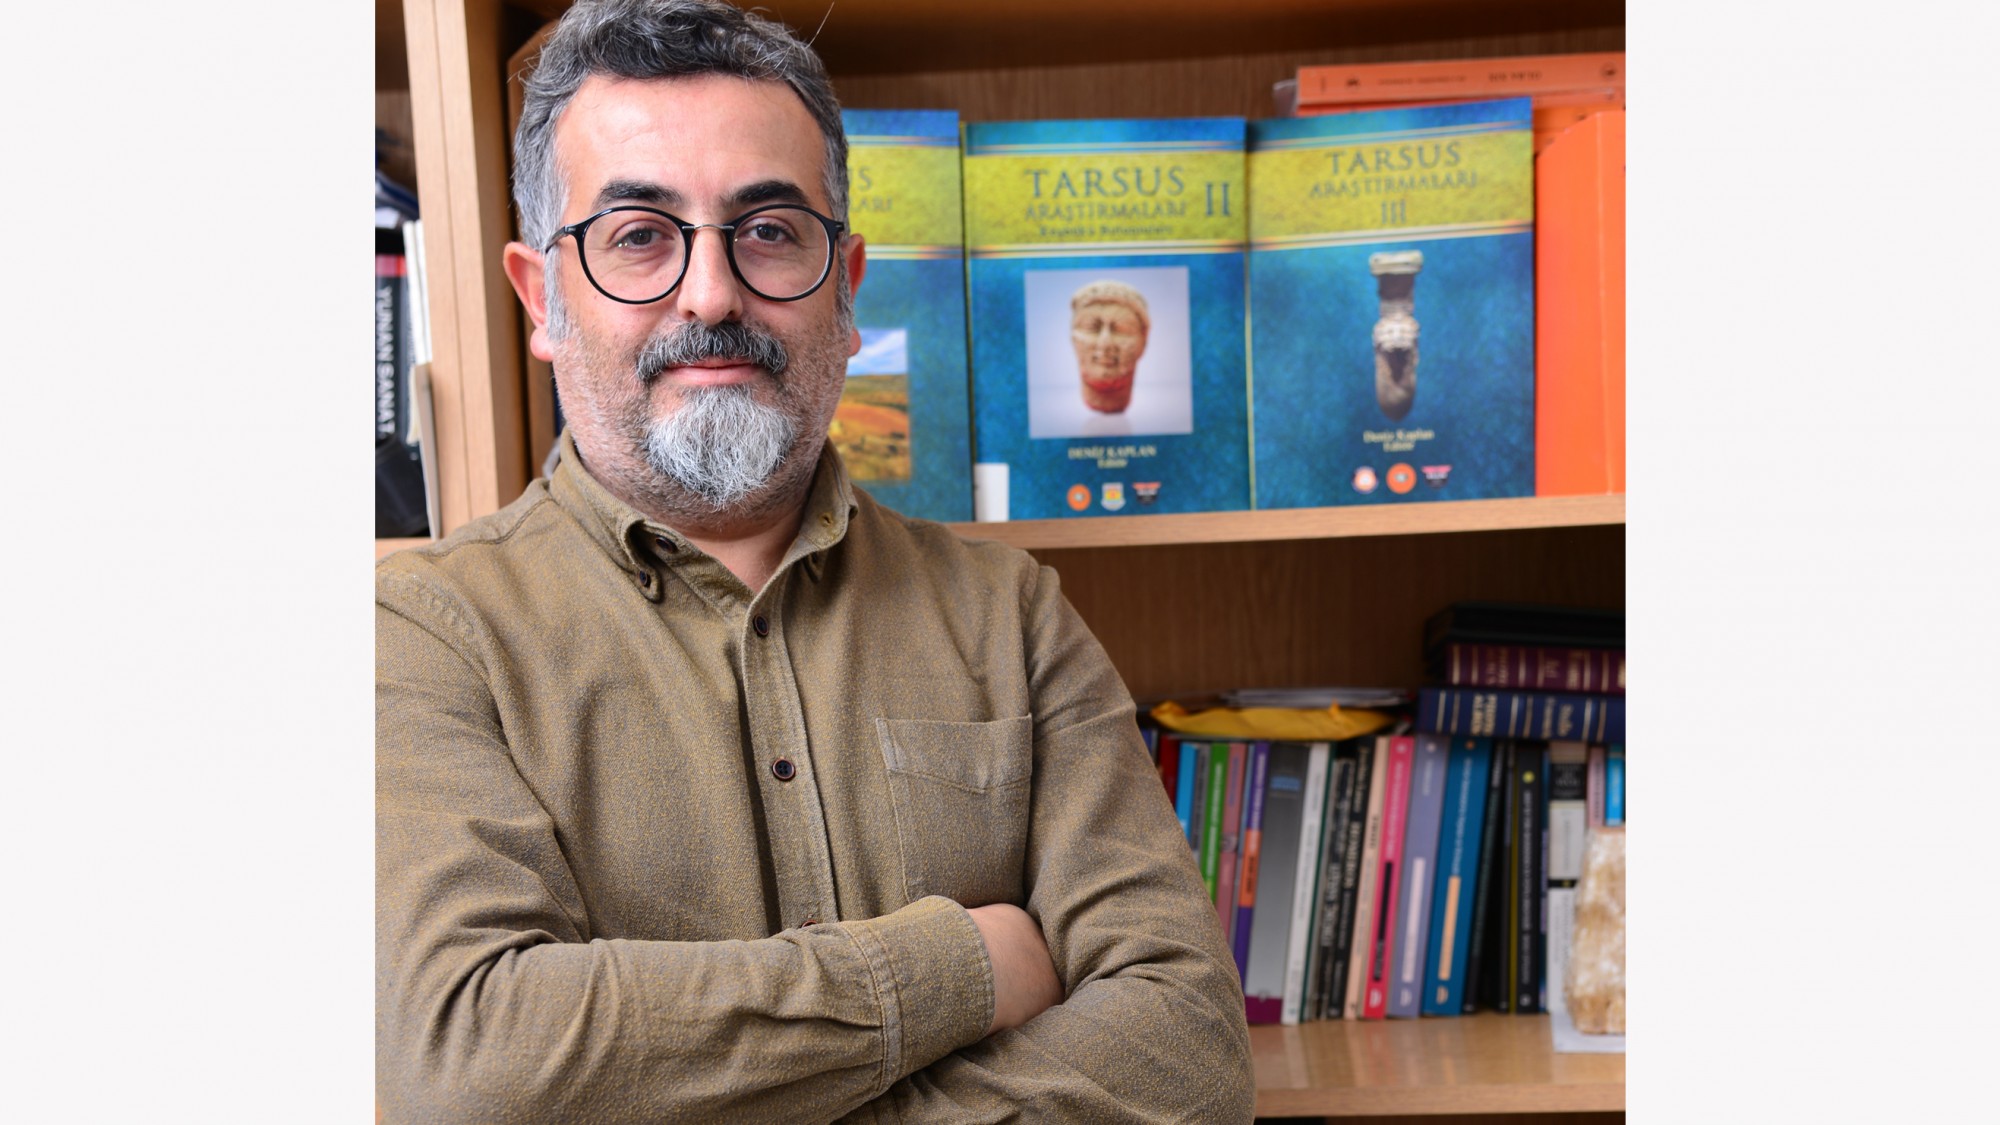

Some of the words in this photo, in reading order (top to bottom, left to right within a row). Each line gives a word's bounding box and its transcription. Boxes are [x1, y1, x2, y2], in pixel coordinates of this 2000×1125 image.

[1324, 141, 1461, 175] TARSUS
[1024, 166, 1185, 198] TARSUS
[1205, 182, 1231, 217] II
[1381, 200, 1407, 224] III
[377, 286, 393, 361] YUNAN
[1106, 444, 1157, 457] KAPLAN
